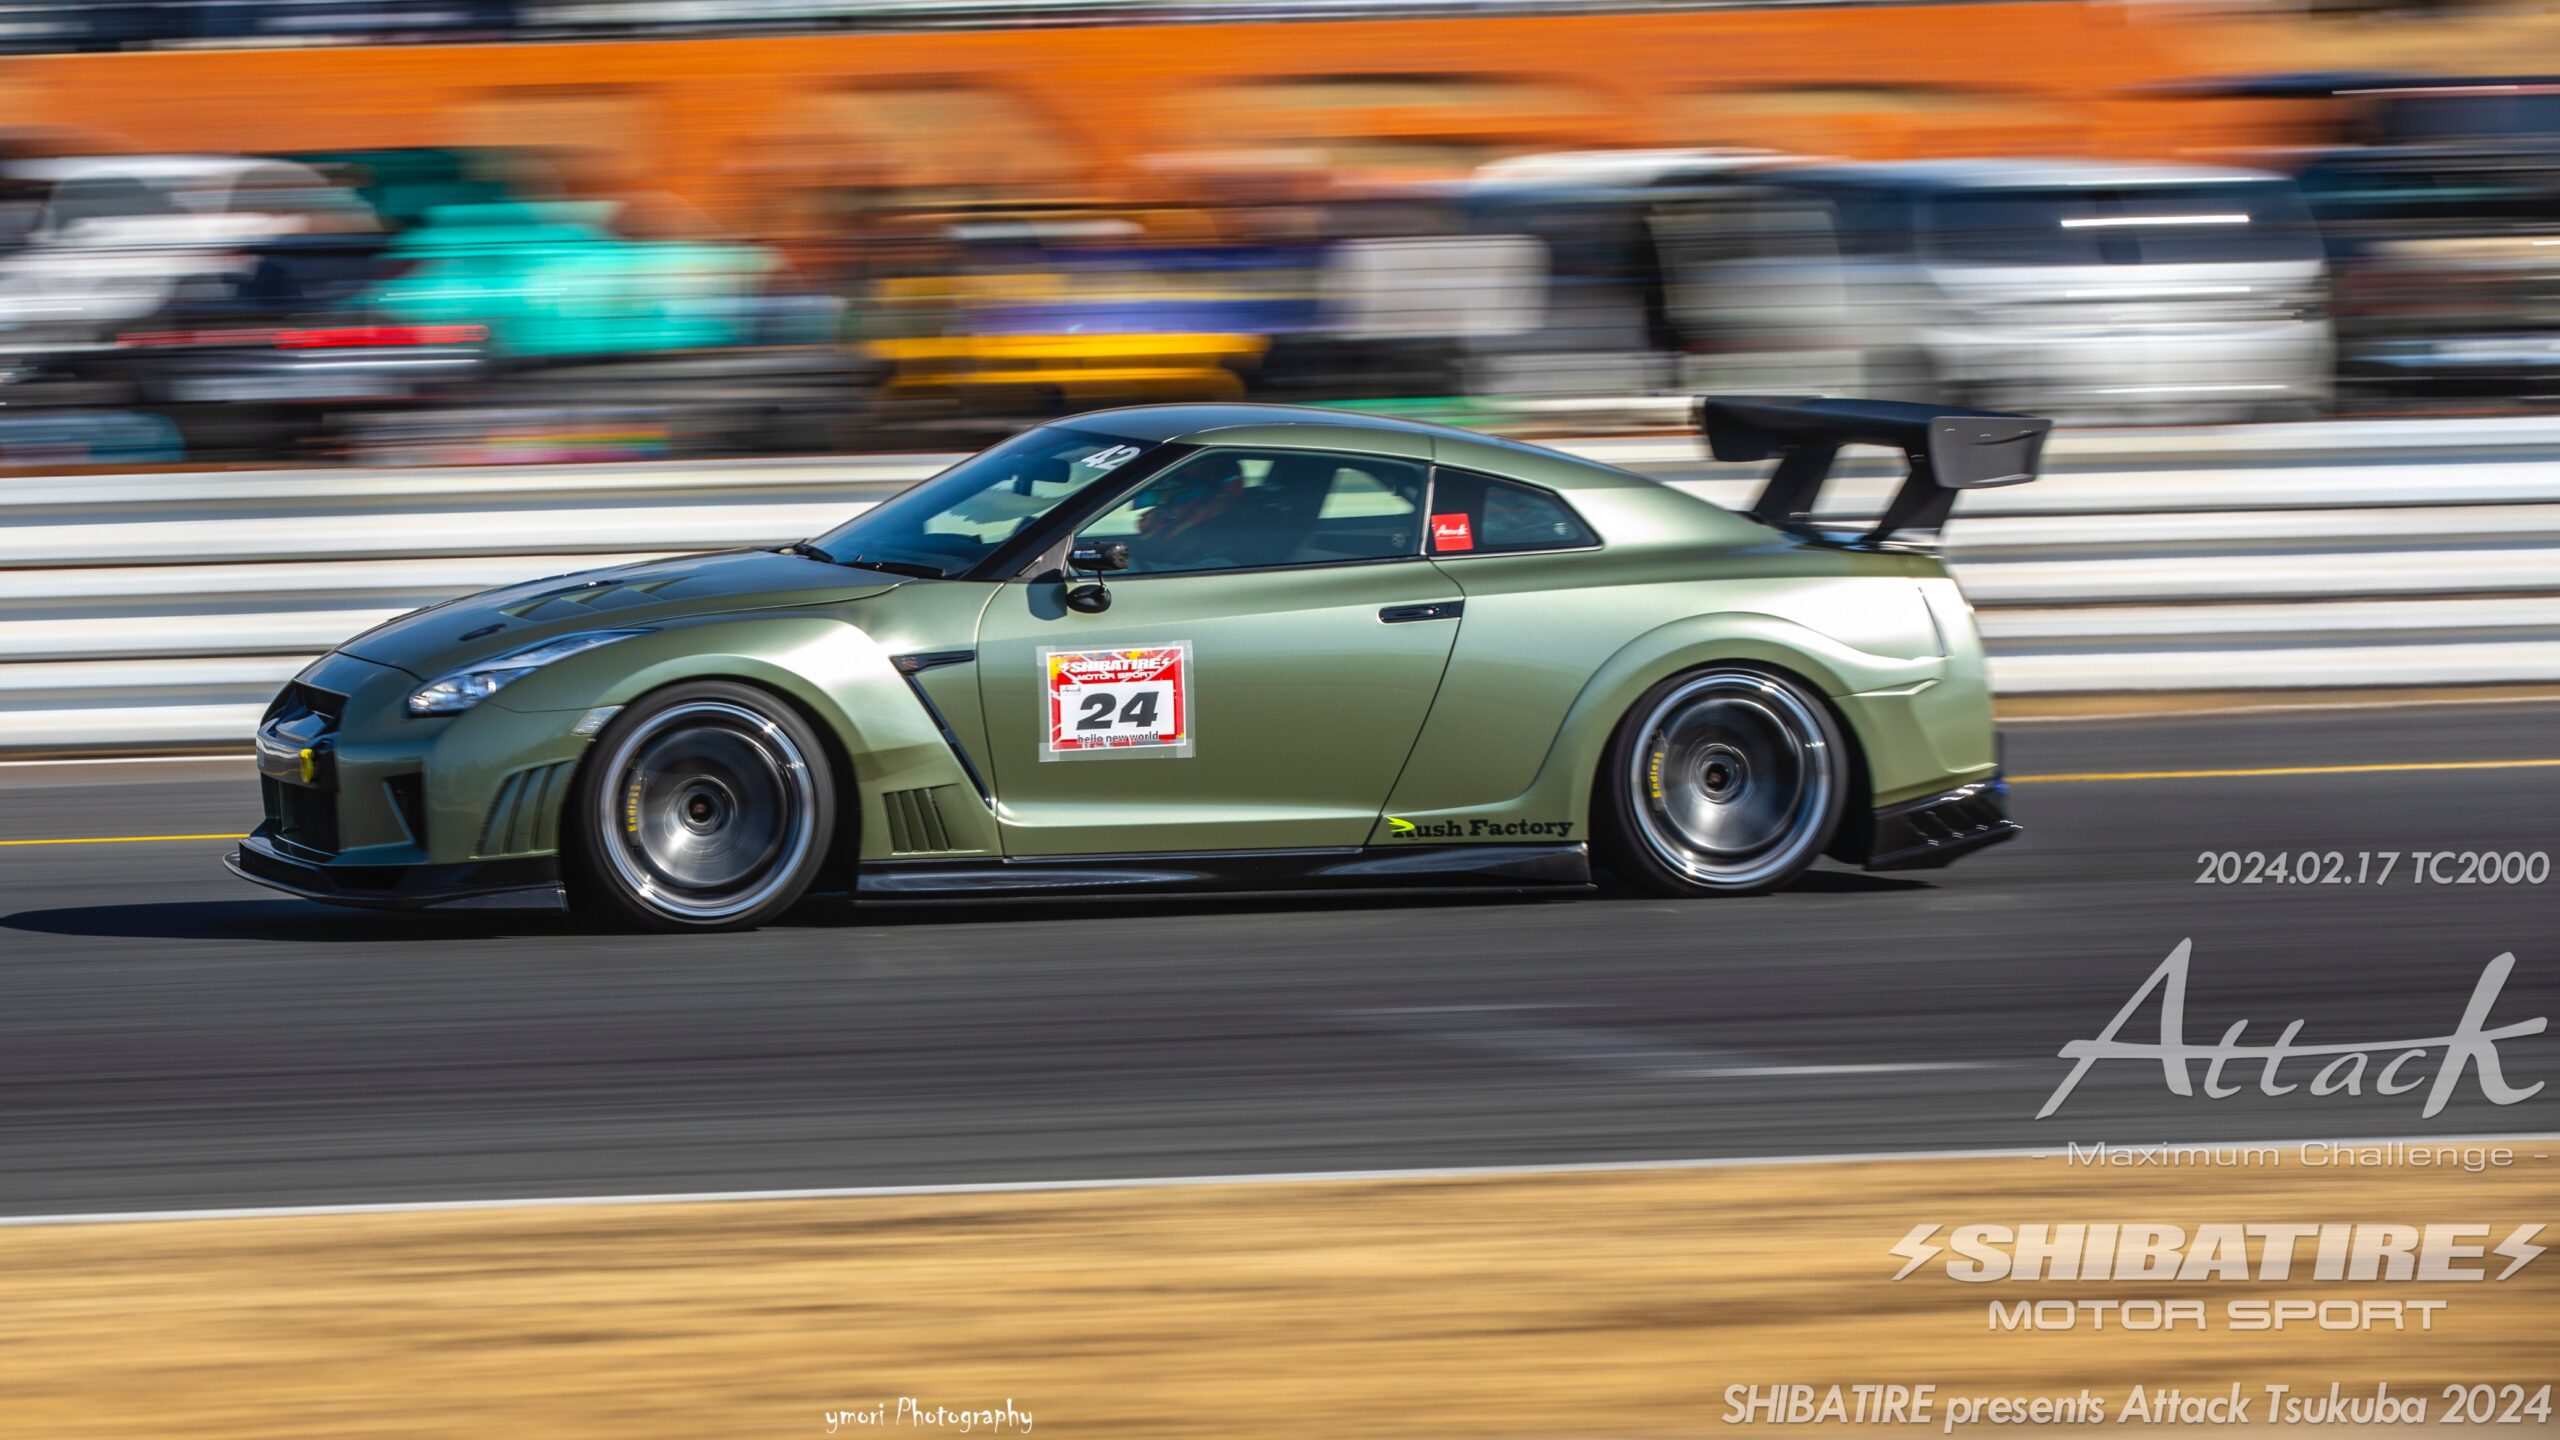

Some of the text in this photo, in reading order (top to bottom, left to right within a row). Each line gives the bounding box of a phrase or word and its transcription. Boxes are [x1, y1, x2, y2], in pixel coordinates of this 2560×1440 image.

[1070, 657, 1161, 673] SHIBATIRE
[1077, 671, 1156, 681] MOTOR SPORT
[1076, 691, 1159, 730] 24
[1077, 733, 1104, 744] hello
[1129, 731, 1159, 742] world
[1469, 819, 1574, 838] Factory
